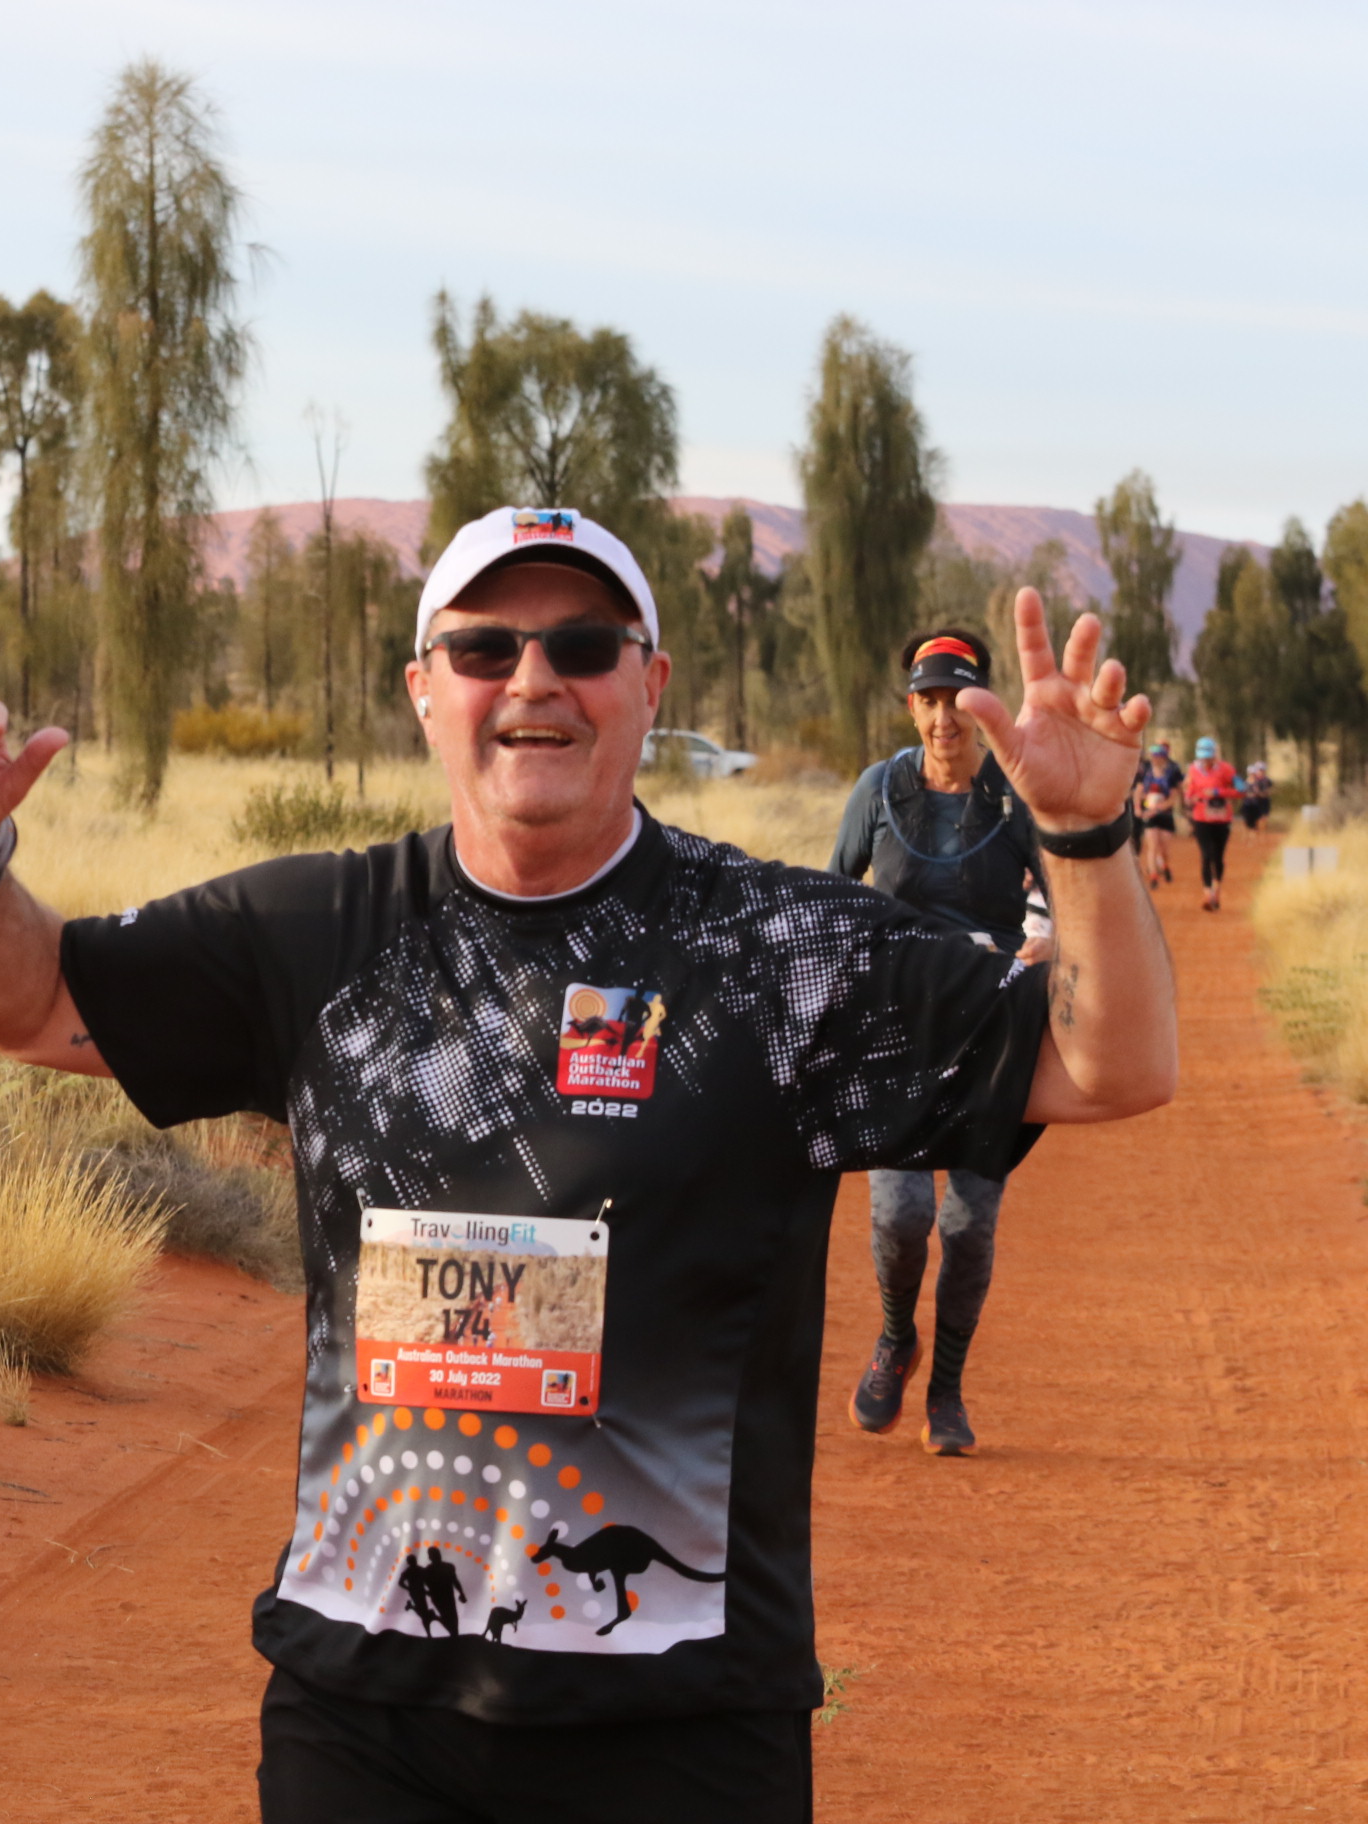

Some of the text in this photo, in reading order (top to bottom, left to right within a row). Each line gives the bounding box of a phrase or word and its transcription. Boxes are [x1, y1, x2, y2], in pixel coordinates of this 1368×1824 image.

[570, 1052, 646, 1069] Australian
[568, 1063, 630, 1077] Outback
[567, 1074, 640, 1090] Marathon
[571, 1099, 638, 1118] 2022
[416, 1257, 526, 1303] TONY
[441, 1307, 490, 1341] 174
[397, 1347, 543, 1368] Australian Outback Marathon
[429, 1369, 501, 1386] 30 July 2022
[434, 1387, 493, 1401] MARATHON
